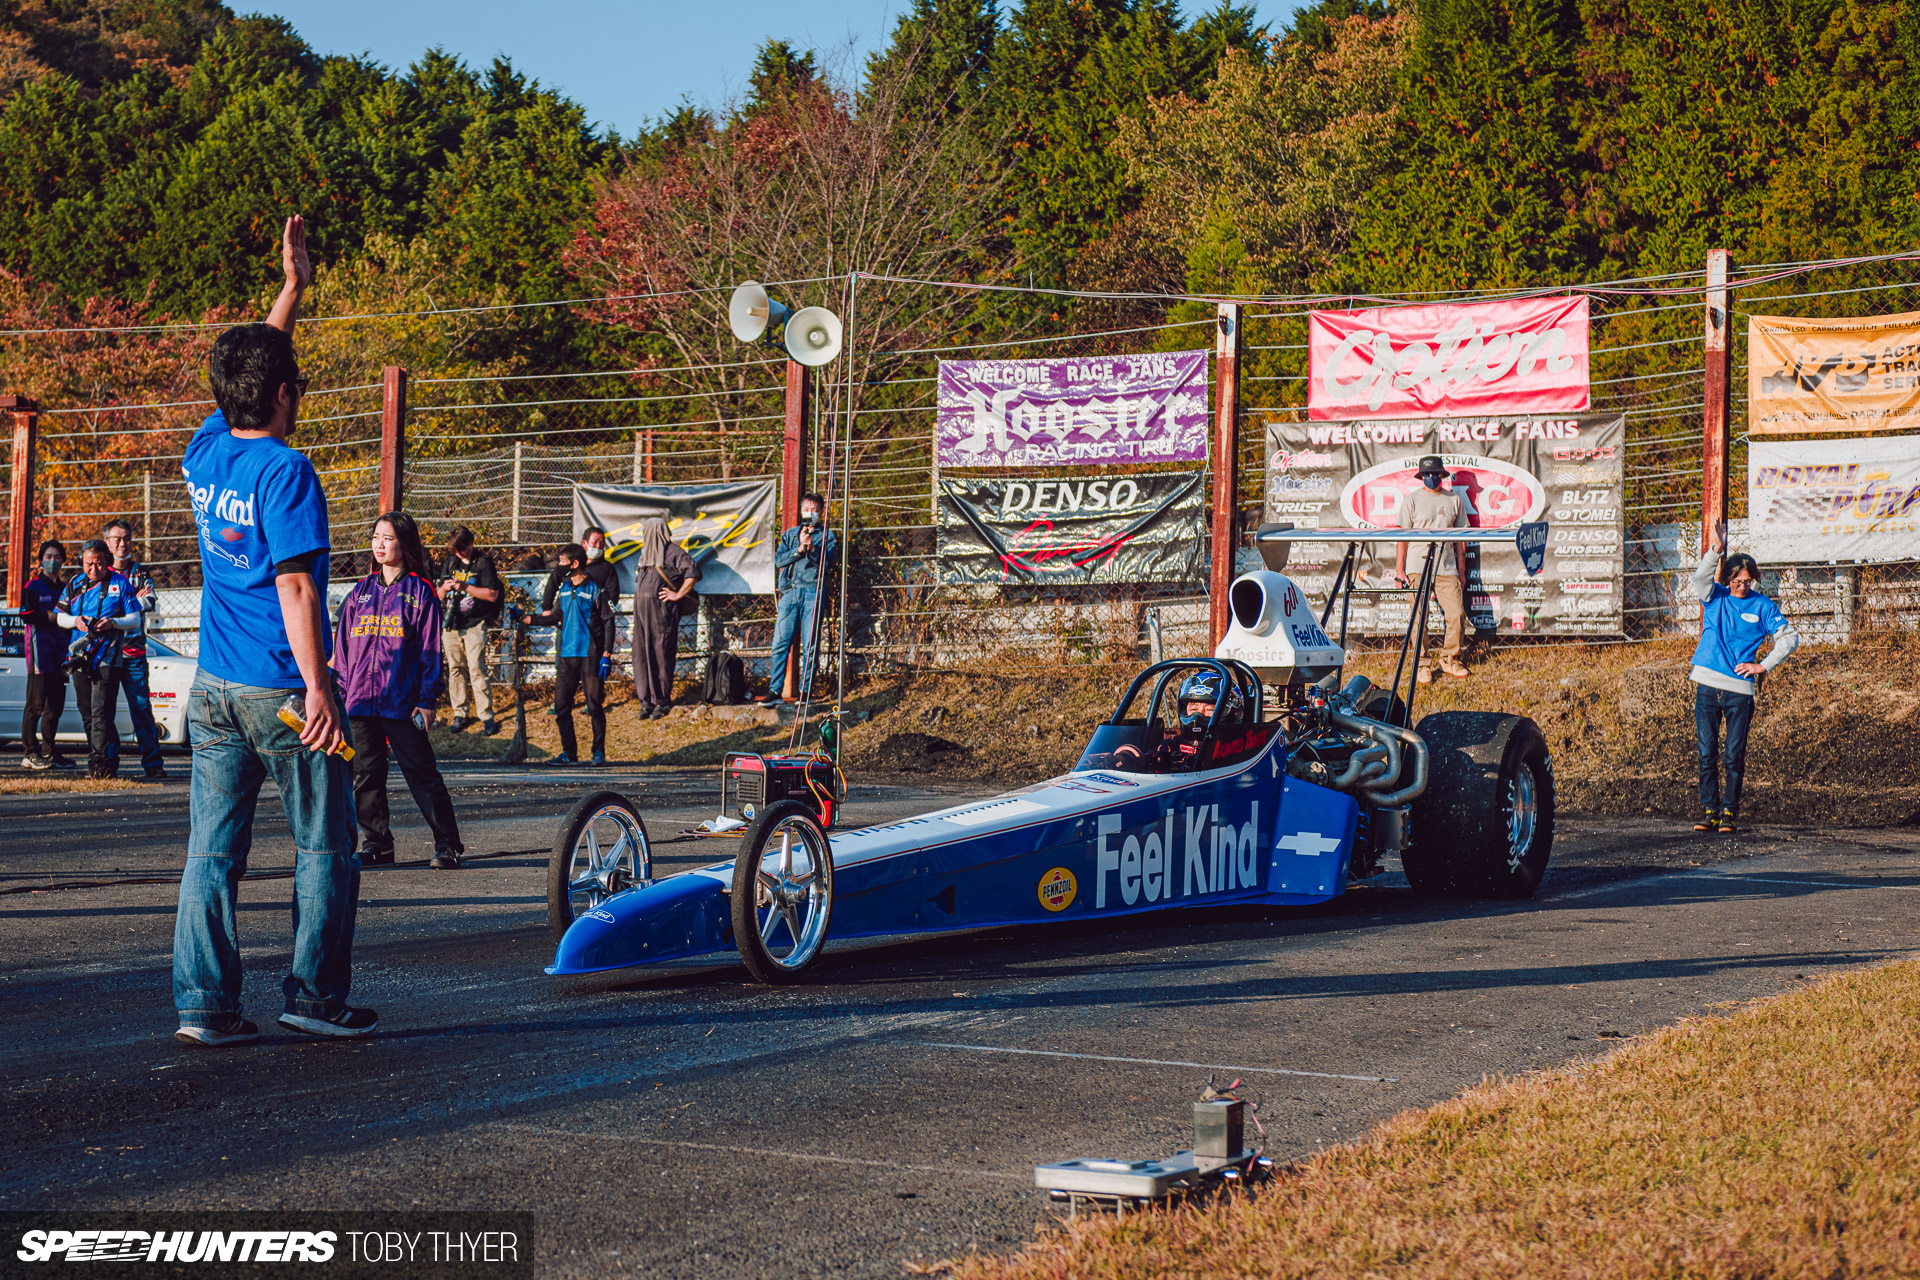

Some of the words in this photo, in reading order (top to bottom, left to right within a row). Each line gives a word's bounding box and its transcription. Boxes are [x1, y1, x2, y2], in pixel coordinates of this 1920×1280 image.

[968, 367, 1051, 383] WELCOME
[1066, 364, 1114, 382] RACE
[1130, 360, 1177, 378] FANS
[1324, 316, 1573, 411] Option
[1882, 360, 1920, 374] TRA
[1309, 424, 1424, 445] WELCOME
[1439, 422, 1500, 442] RACE
[1516, 420, 1580, 440] FANS
[1025, 443, 1115, 461] RACING
[1441, 455, 1480, 468] ESTIVAL
[1752, 463, 1859, 489] ROYAL
[1002, 479, 1138, 512] DENSO
[1562, 489, 1610, 505] BLITZ
[215, 488, 255, 527] Kind
[1271, 502, 1331, 513] TRUST
[1572, 508, 1617, 521] TOMEI
[1554, 529, 1617, 542] DENSO
[1821, 521, 1915, 535] SYNTHETIC
[1519, 529, 1532, 551] Feel
[1532, 525, 1546, 547] Kind
[1470, 570, 1503, 579] RISING
[359, 614, 402, 626] DRAG
[1291, 624, 1312, 647] Feel
[1225, 646, 1286, 662] Hoosier
[1096, 808, 1175, 909] Feel
[1183, 800, 1259, 896] Kind
[1042, 878, 1072, 900] PENNZOIL
